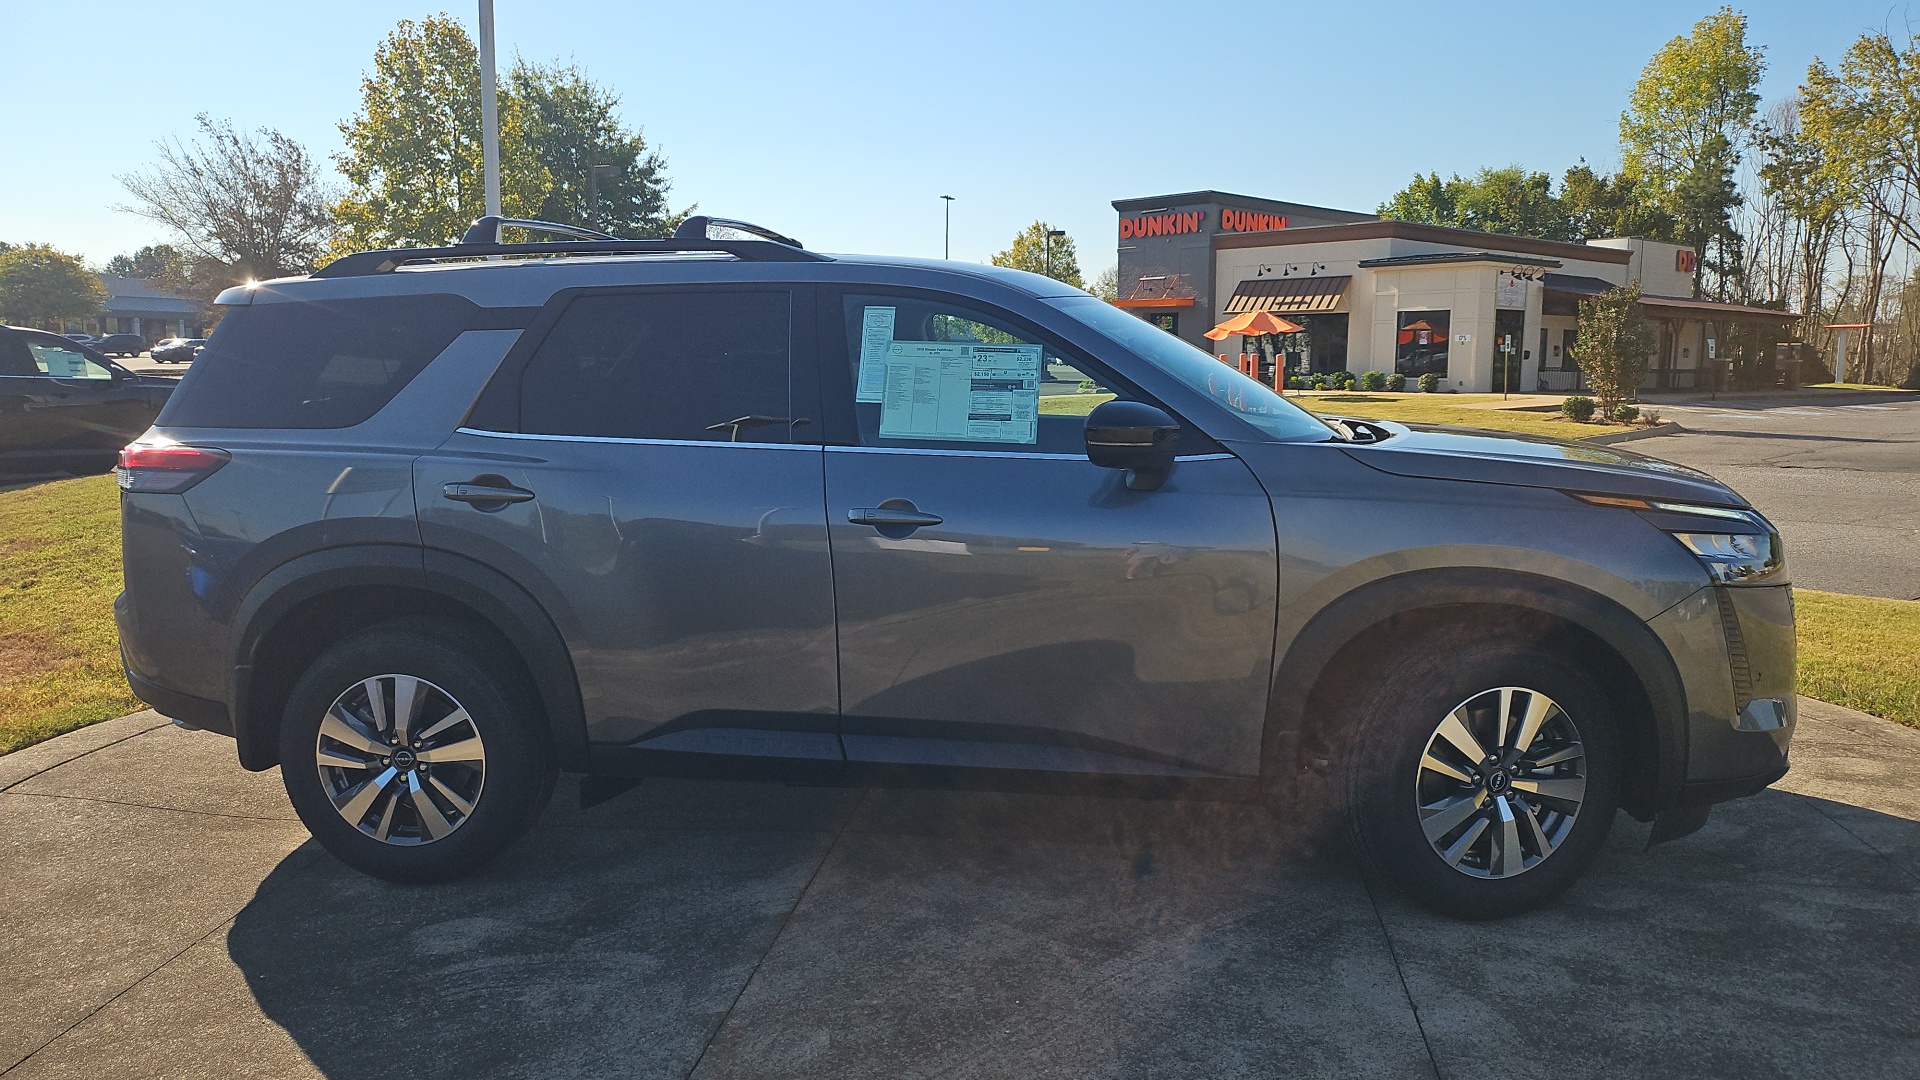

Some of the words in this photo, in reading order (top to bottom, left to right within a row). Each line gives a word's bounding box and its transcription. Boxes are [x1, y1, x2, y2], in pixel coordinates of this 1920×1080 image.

[1120, 211, 1205, 239] DUNKIN'
[1221, 209, 1290, 232] DUNKIN'
[1675, 249, 1697, 273] DD
